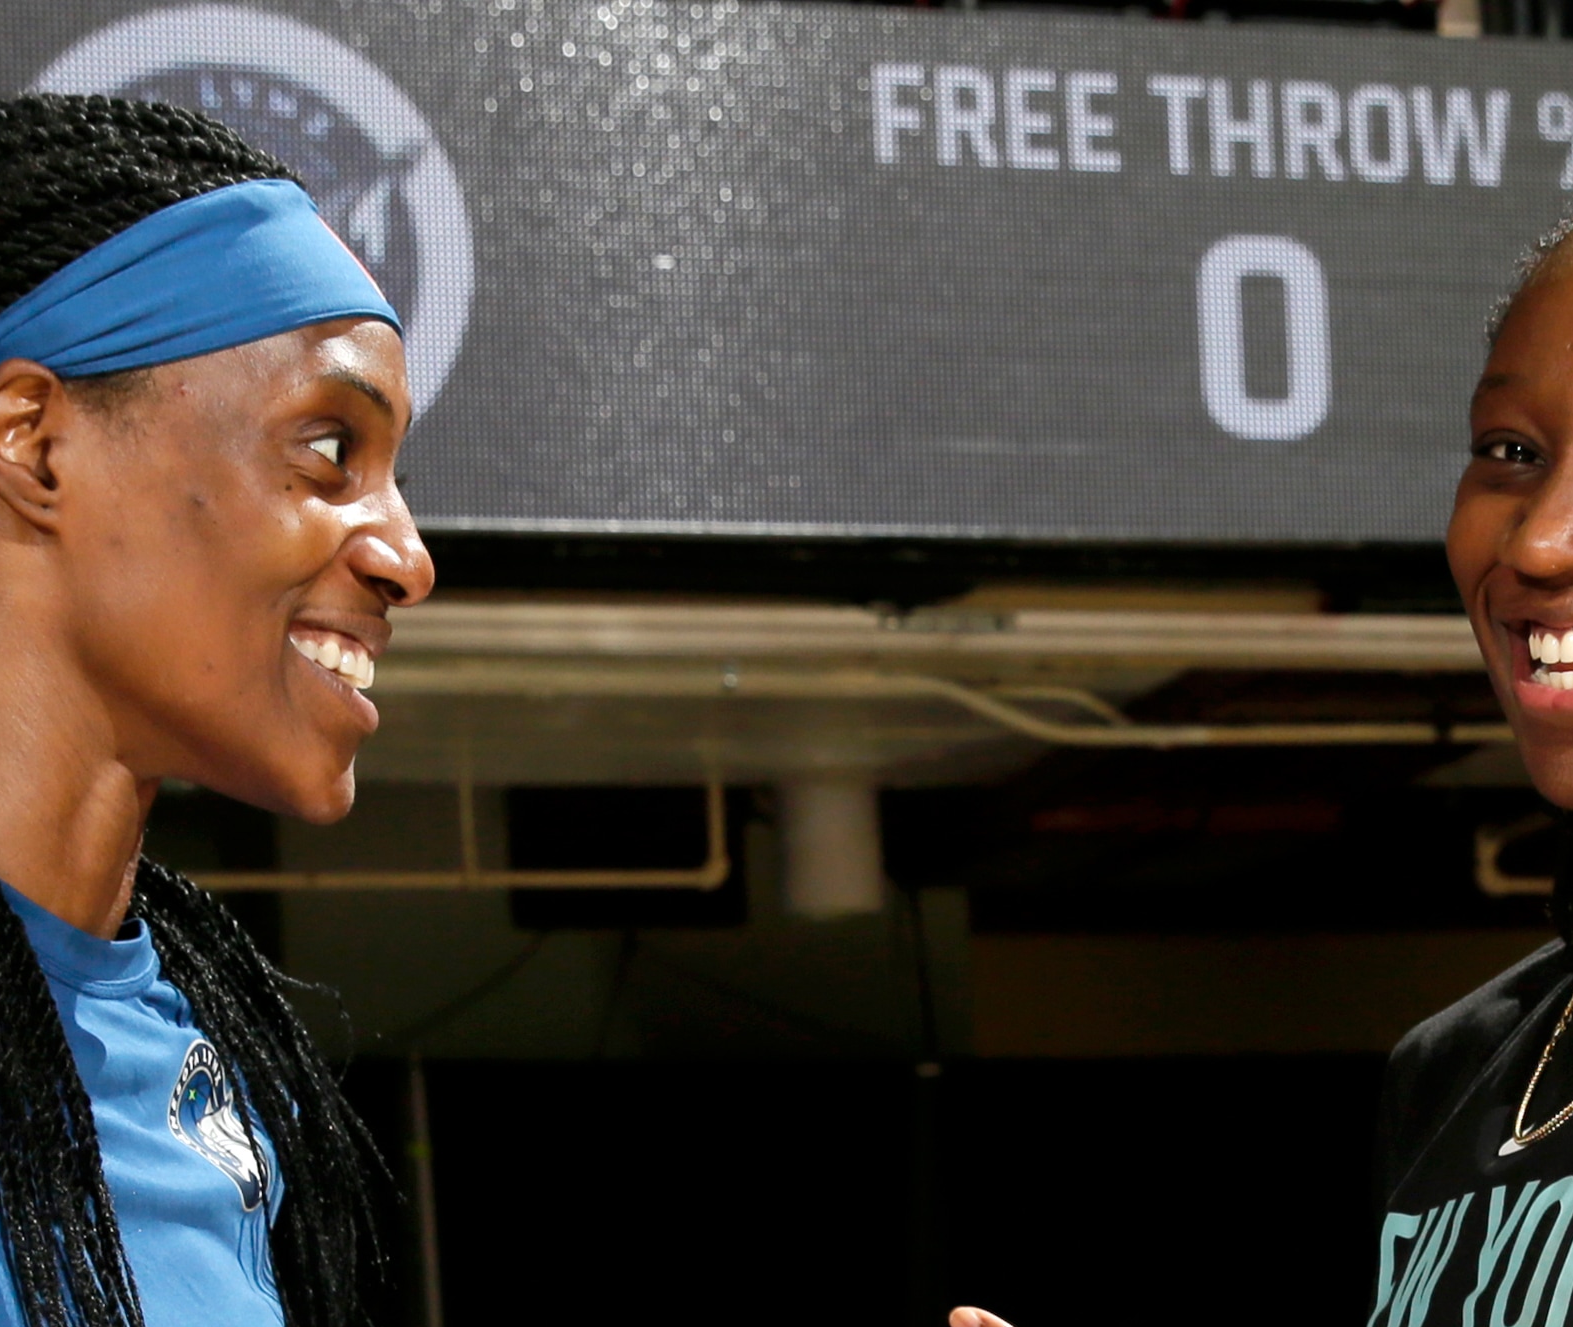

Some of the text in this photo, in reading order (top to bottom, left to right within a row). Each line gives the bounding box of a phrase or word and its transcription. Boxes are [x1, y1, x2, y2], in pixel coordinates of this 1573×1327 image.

[870, 63, 1122, 173] FREE
[1147, 74, 1511, 187] THROW
[1196, 235, 1333, 441] 0
